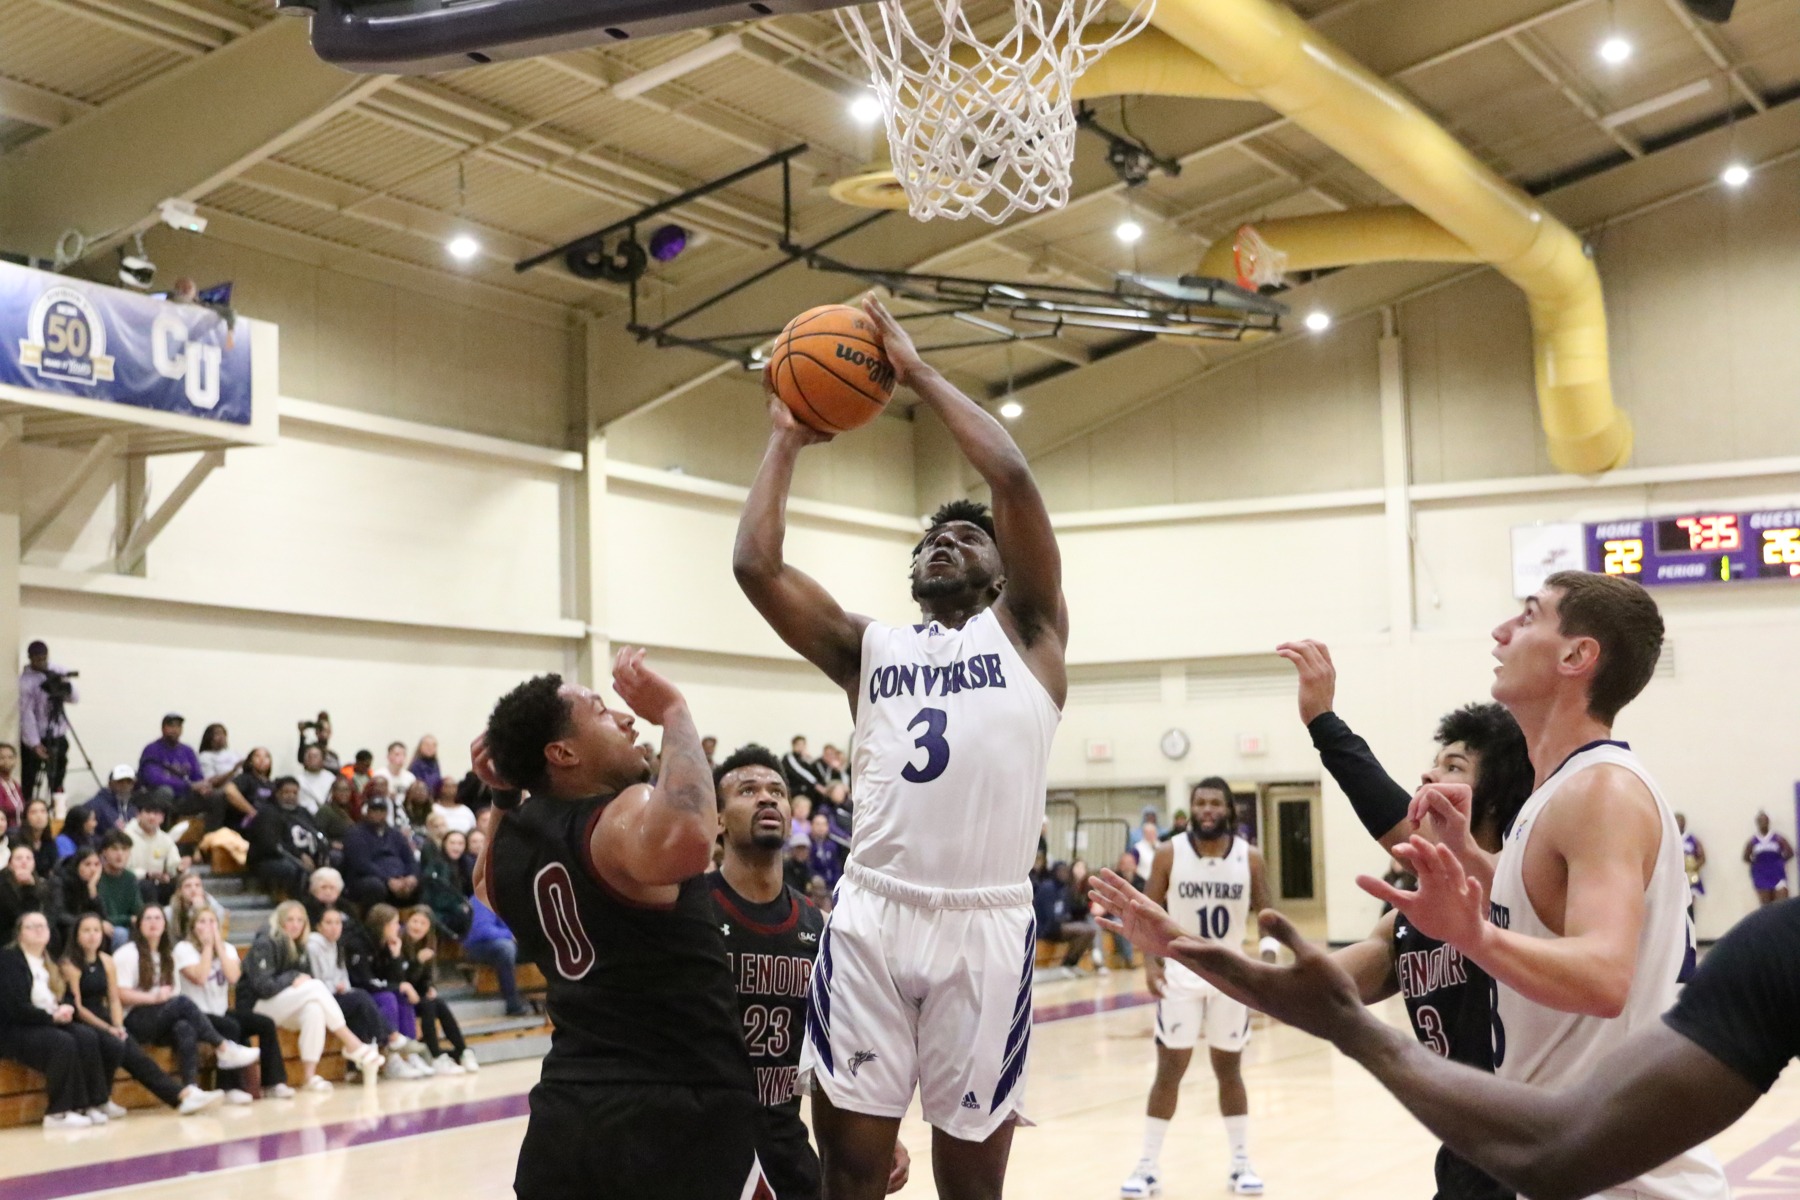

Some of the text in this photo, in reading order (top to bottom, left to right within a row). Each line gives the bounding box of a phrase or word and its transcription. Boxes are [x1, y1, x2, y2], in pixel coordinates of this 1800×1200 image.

[47, 313, 88, 358] 50
[152, 313, 222, 410] CU
[836, 343, 896, 394] Wilson
[1596, 522, 1643, 540] HOME
[1676, 514, 1740, 551] 7:35
[1762, 528, 1800, 565] 26
[1604, 539, 1643, 575] 22
[1657, 563, 1707, 579] PERIOD
[1721, 554, 1730, 581] 1
[869, 653, 1007, 705] CONVERSE
[901, 707, 950, 783] 3
[533, 862, 596, 981] 0
[800, 931, 817, 942] SAC
[1196, 905, 1230, 939] 10
[1395, 943, 1467, 999] ENOIR
[743, 1004, 792, 1057] 23
[1416, 1005, 1450, 1058] 3
[756, 1066, 799, 1106] YNE
